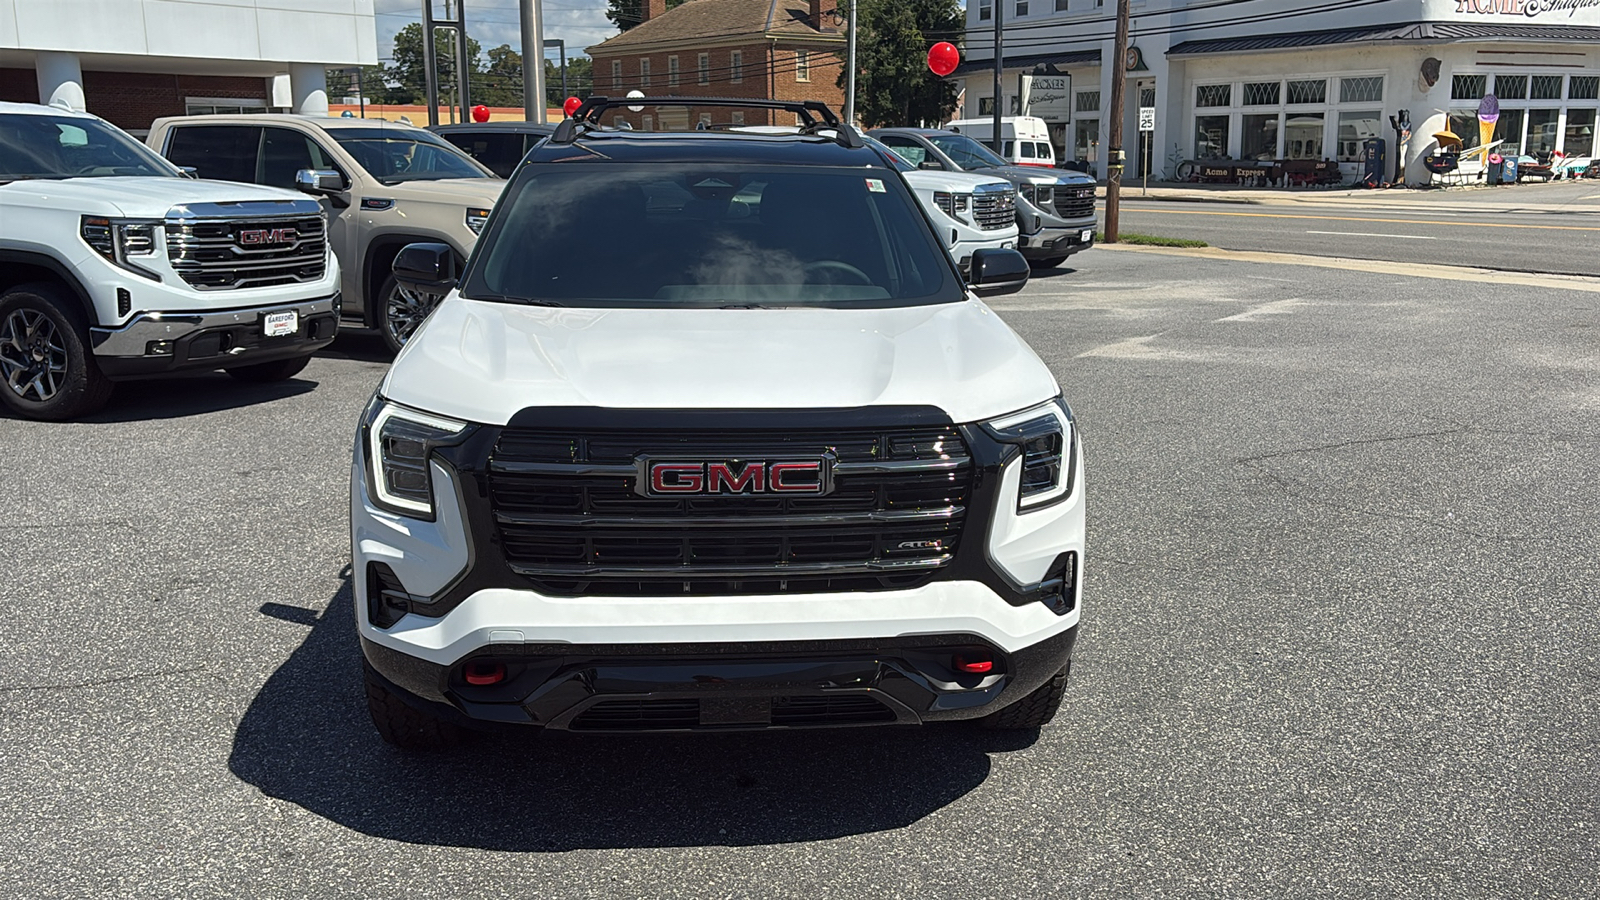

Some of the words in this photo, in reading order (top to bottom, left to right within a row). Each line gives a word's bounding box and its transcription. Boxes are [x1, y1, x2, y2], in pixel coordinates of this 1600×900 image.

[1141, 119, 1153, 128] 25
[1205, 168, 1228, 176] Acme
[1236, 168, 1266, 177] Express
[240, 228, 296, 244] GMC
[652, 462, 820, 493] GMC
